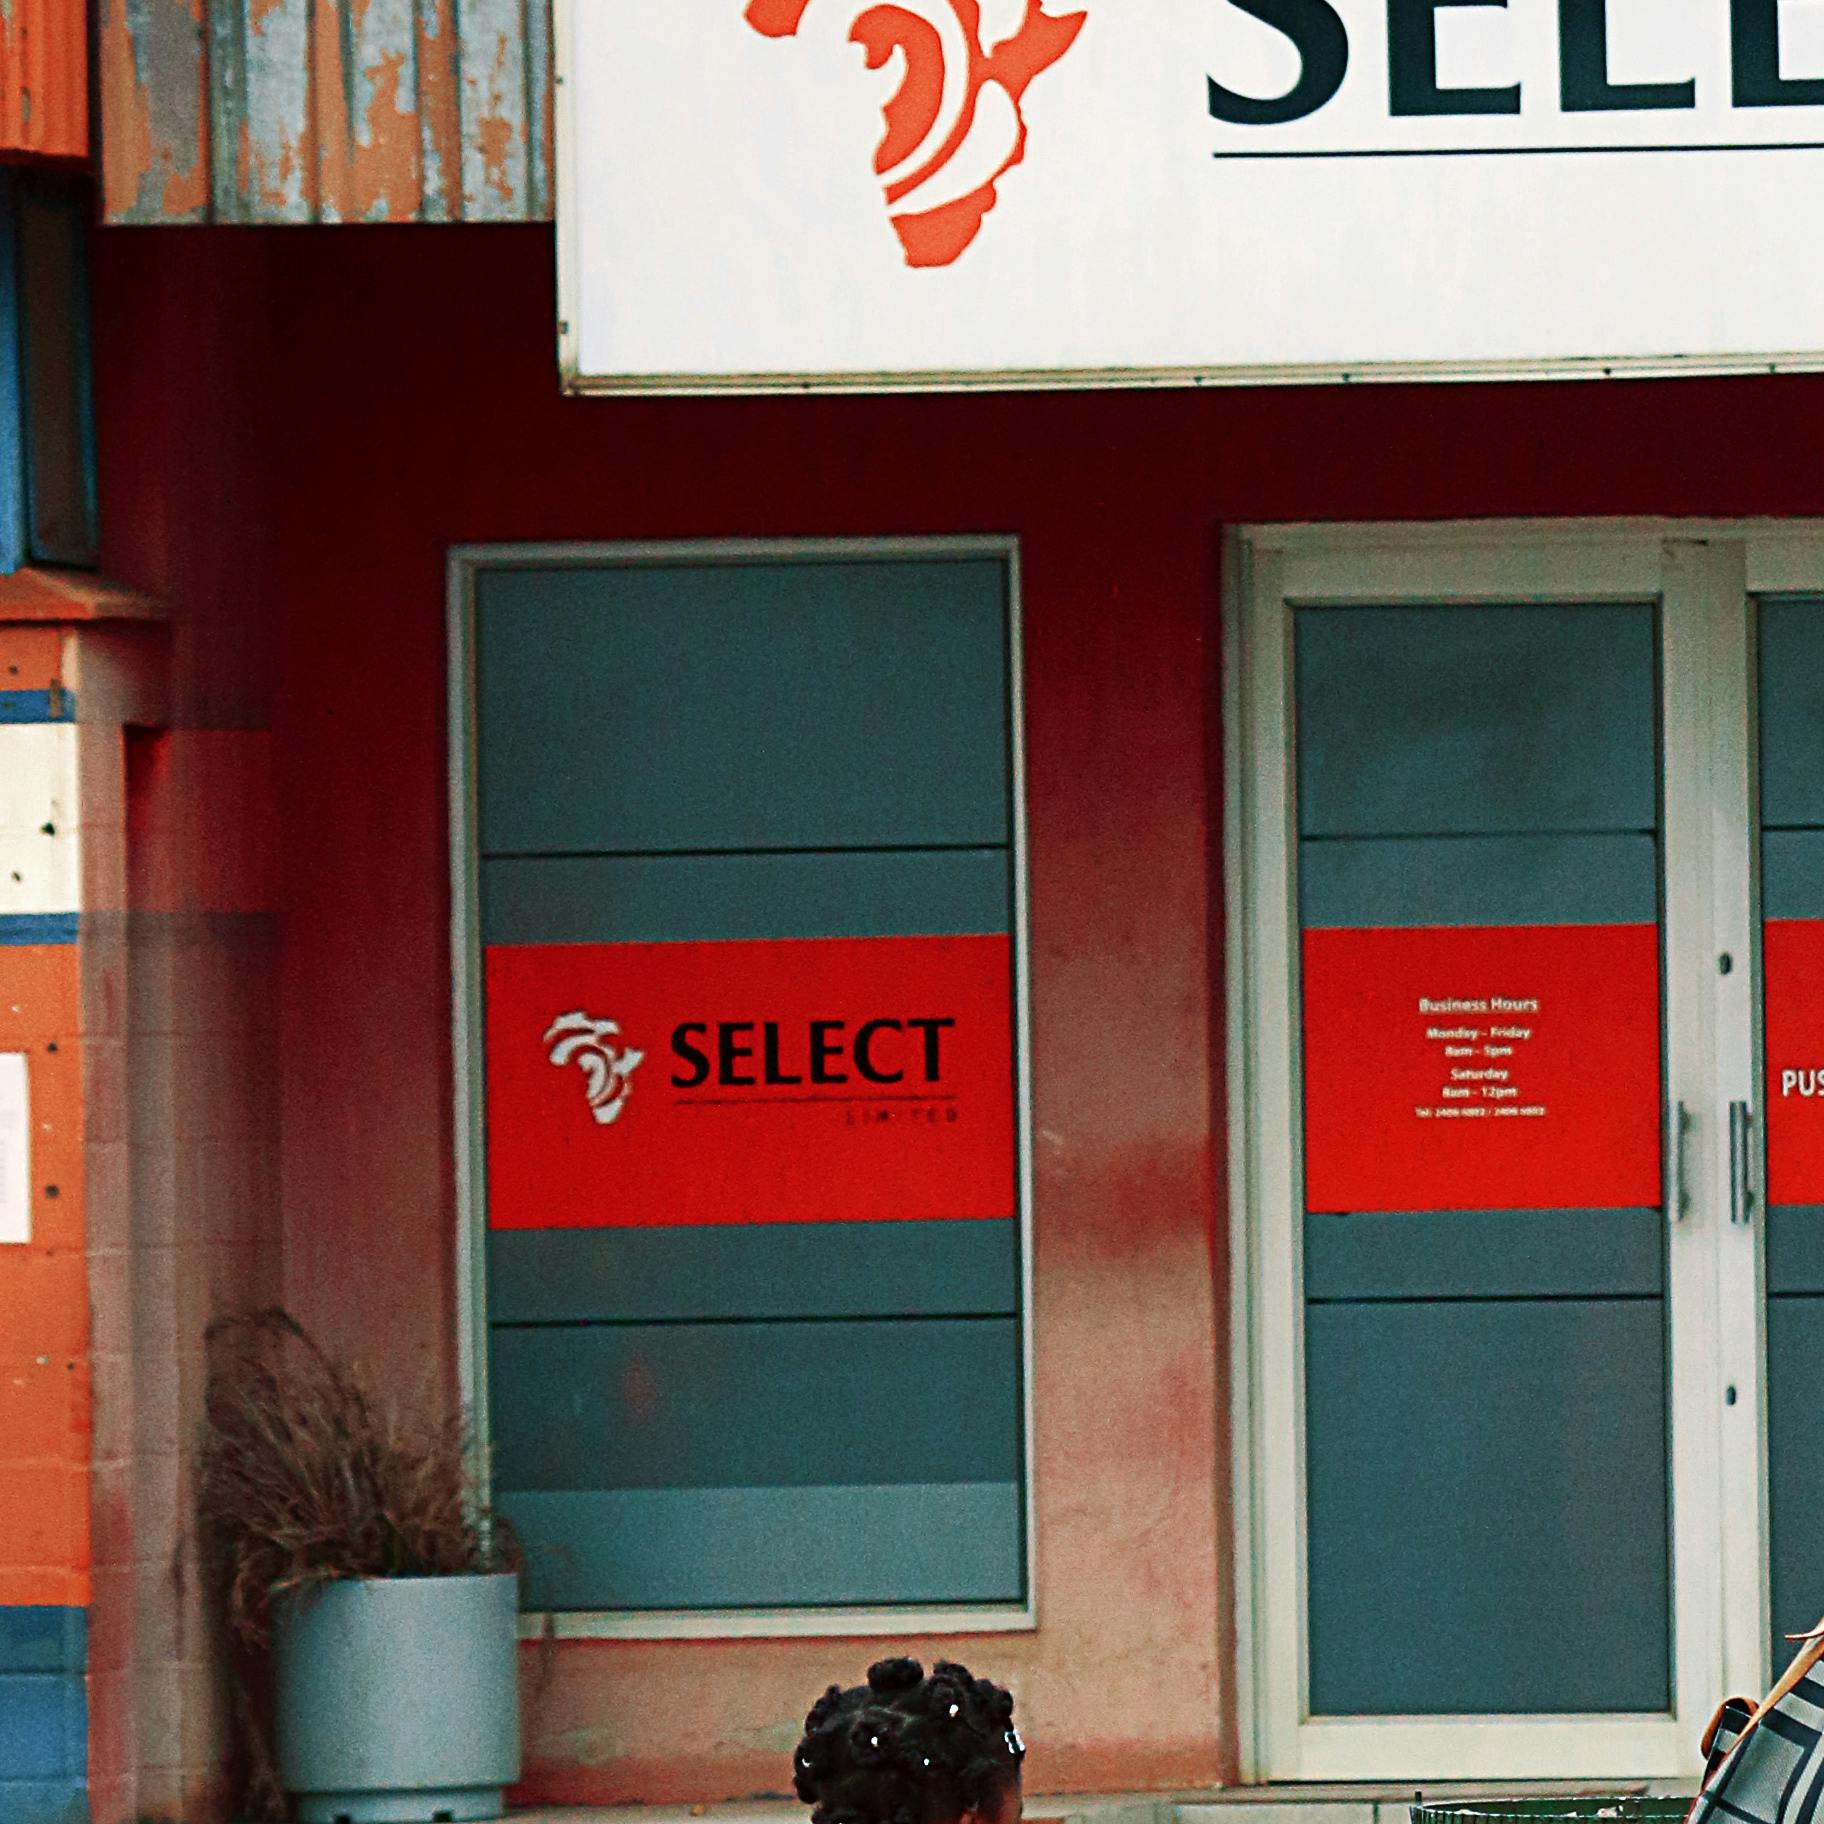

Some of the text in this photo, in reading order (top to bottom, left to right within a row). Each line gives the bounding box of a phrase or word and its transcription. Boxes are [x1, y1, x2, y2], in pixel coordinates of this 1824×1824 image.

[1419, 996, 1538, 1013] Business Hours
[1426, 1026, 1478, 1041] Monday
[1490, 1025, 1531, 1040] Friday
[671, 1017, 955, 1088] SELECT
[1450, 1067, 1509, 1082] Saturday
[845, 1107, 958, 1126] LIMTED
